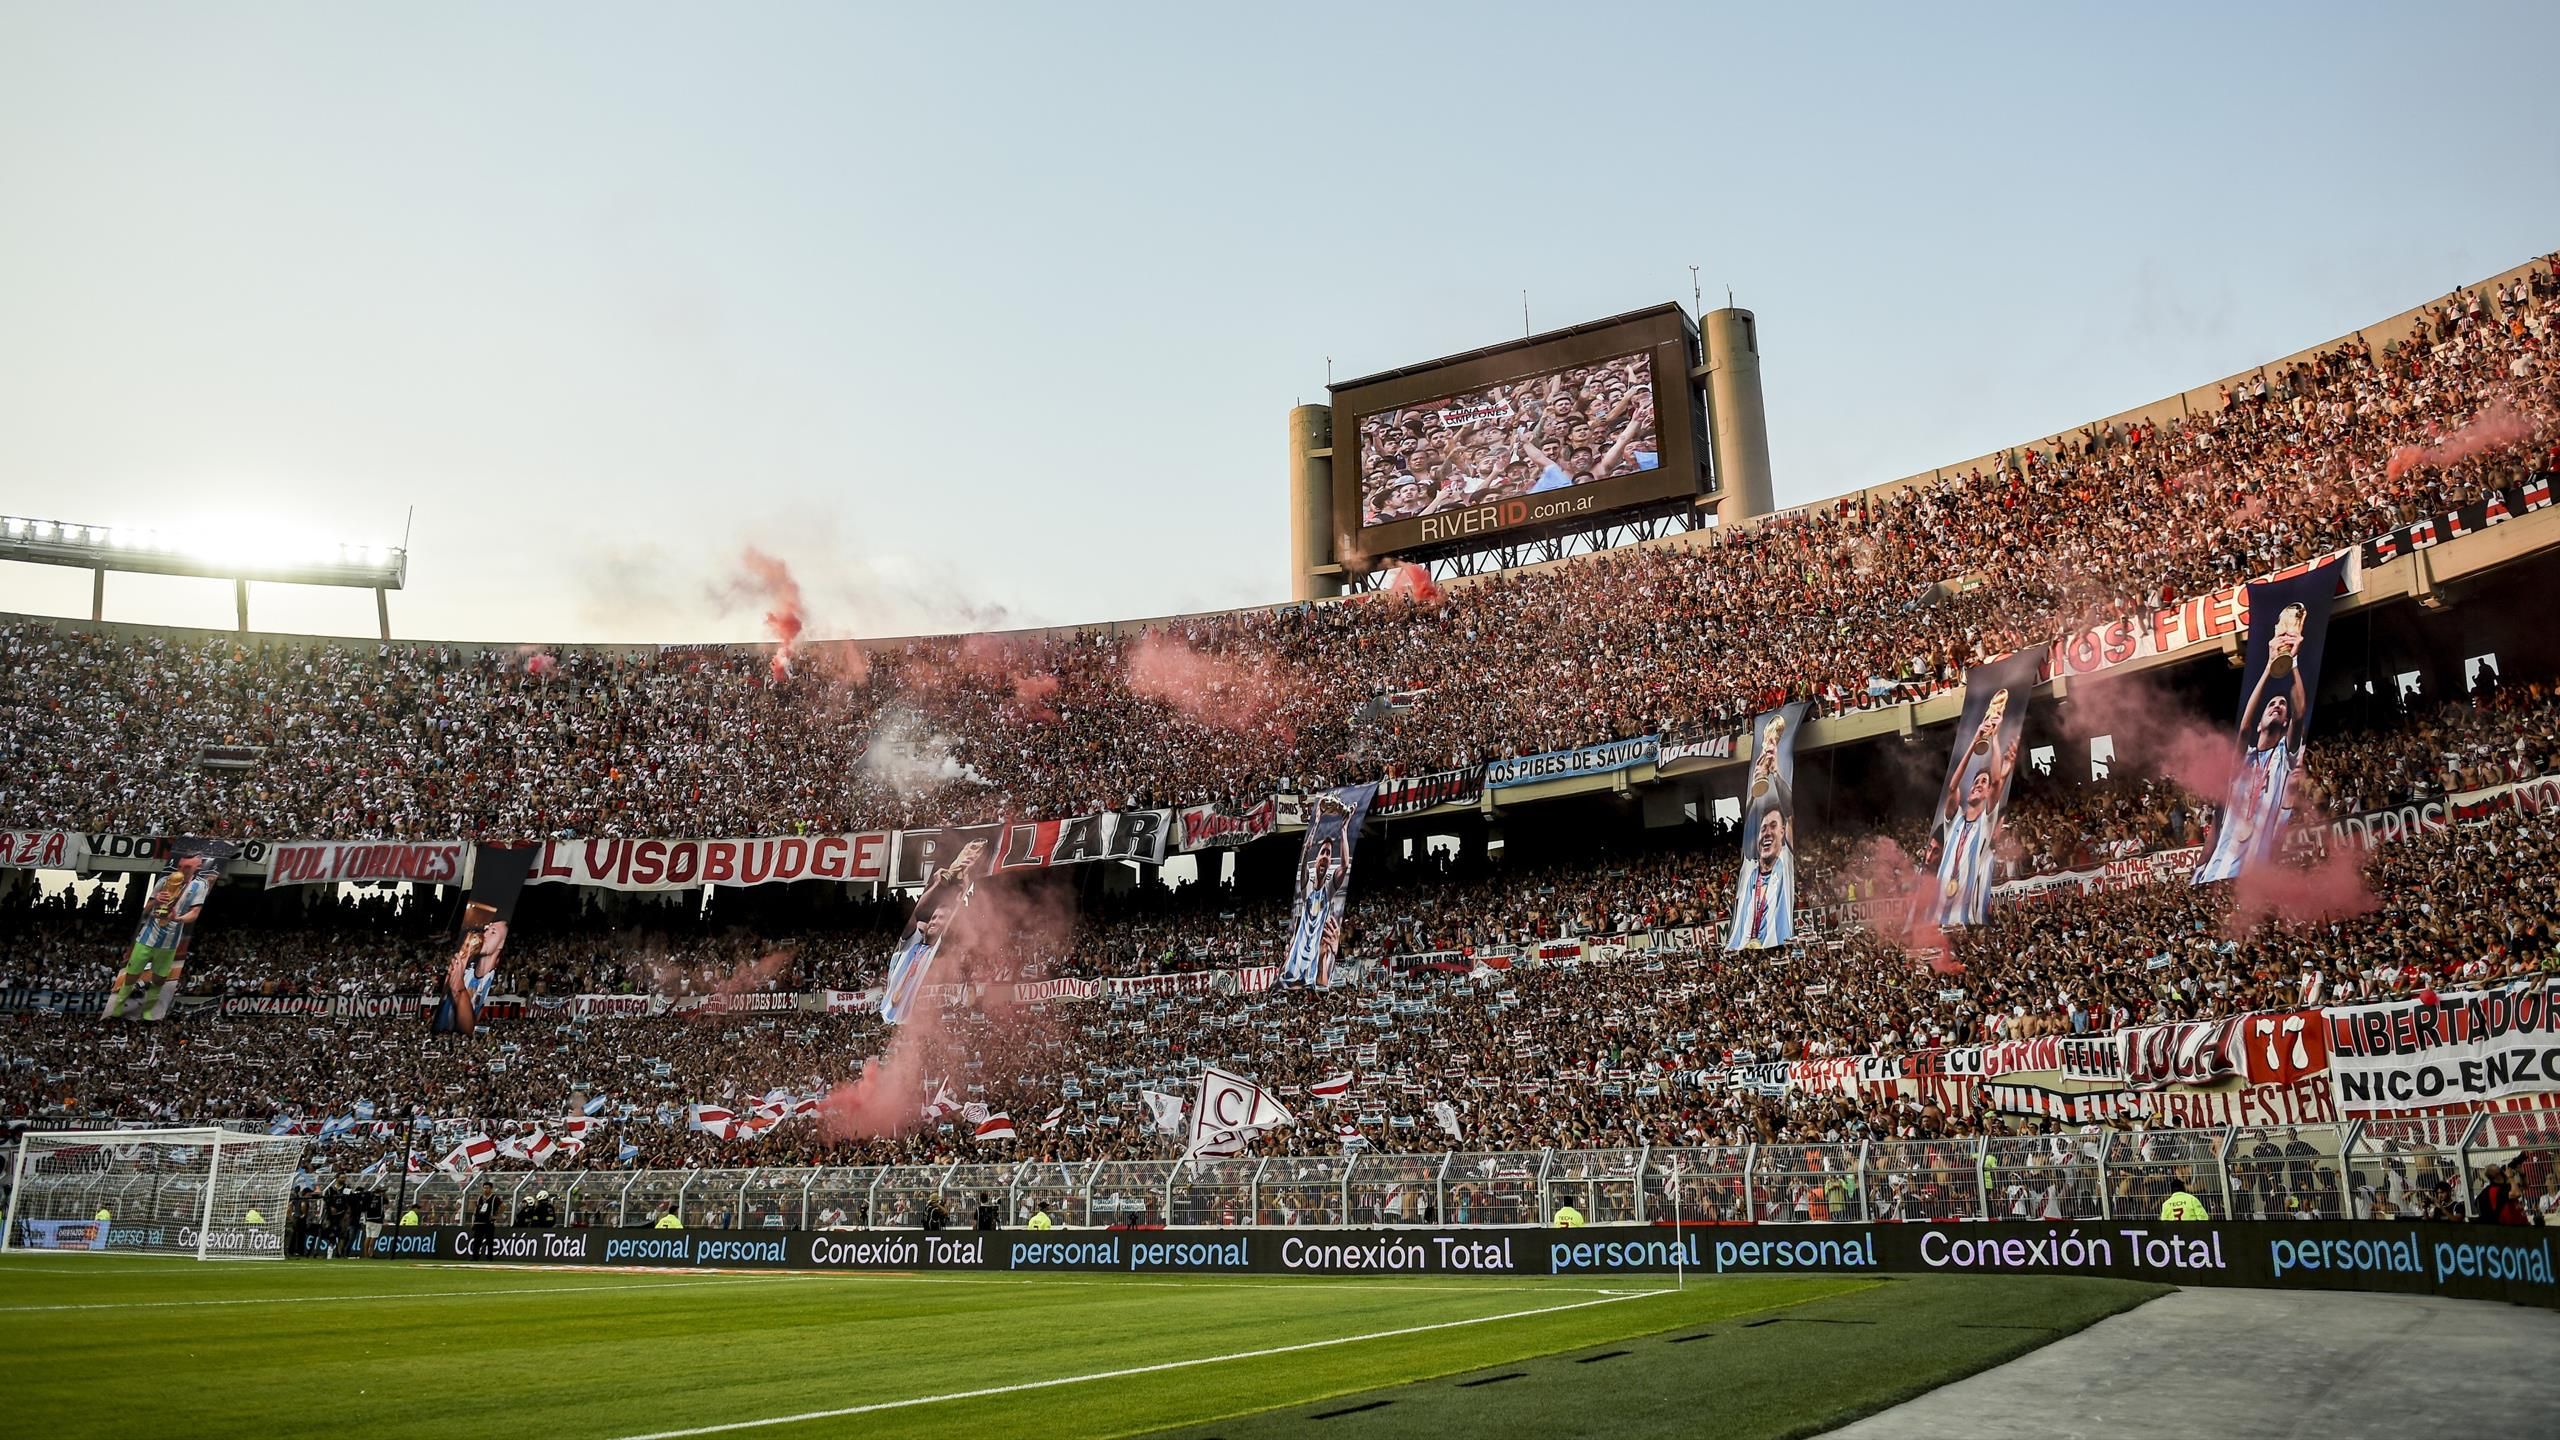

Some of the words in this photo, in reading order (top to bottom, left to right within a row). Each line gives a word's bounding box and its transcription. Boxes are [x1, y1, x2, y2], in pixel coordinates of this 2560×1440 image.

[1489, 760, 1515, 784] LOS
[1519, 749, 1566, 780] PIBES
[1572, 748, 1591, 770] DE
[1596, 741, 1643, 767] SAVIO
[272, 844, 461, 884] POLVORINES
[584, 839, 699, 884] VISO
[702, 835, 884, 882] BUDGE
[729, 994, 743, 1011] LOS
[746, 994, 770, 1011] PIBES
[773, 993, 786, 1010] DEL
[789, 992, 798, 1009] 30
[1017, 980, 1099, 1001] V.DOMINICO
[1863, 1049, 1981, 1078] PACHECO
[1983, 1036, 2061, 1077] GARIN
[178, 1226, 246, 1249] Coexión
[543, 1233, 587, 1257] Total
[605, 1234, 690, 1262] personal
[697, 1236, 787, 1265] personal
[811, 1236, 919, 1264] Conexión
[925, 1236, 984, 1264] Total
[1010, 1236, 1120, 1270] personal
[1131, 1237, 1249, 1271] personal
[1282, 1237, 1425, 1269] Conexión
[1433, 1237, 1514, 1269] Total
[1551, 1233, 1701, 1274] personal
[1715, 1232, 1878, 1273] personal
[1920, 1229, 2112, 1267] Conexión
[2120, 1229, 2227, 1269] Total
[2271, 1231, 2424, 1277] personal
[2434, 1237, 2555, 1285] personal
